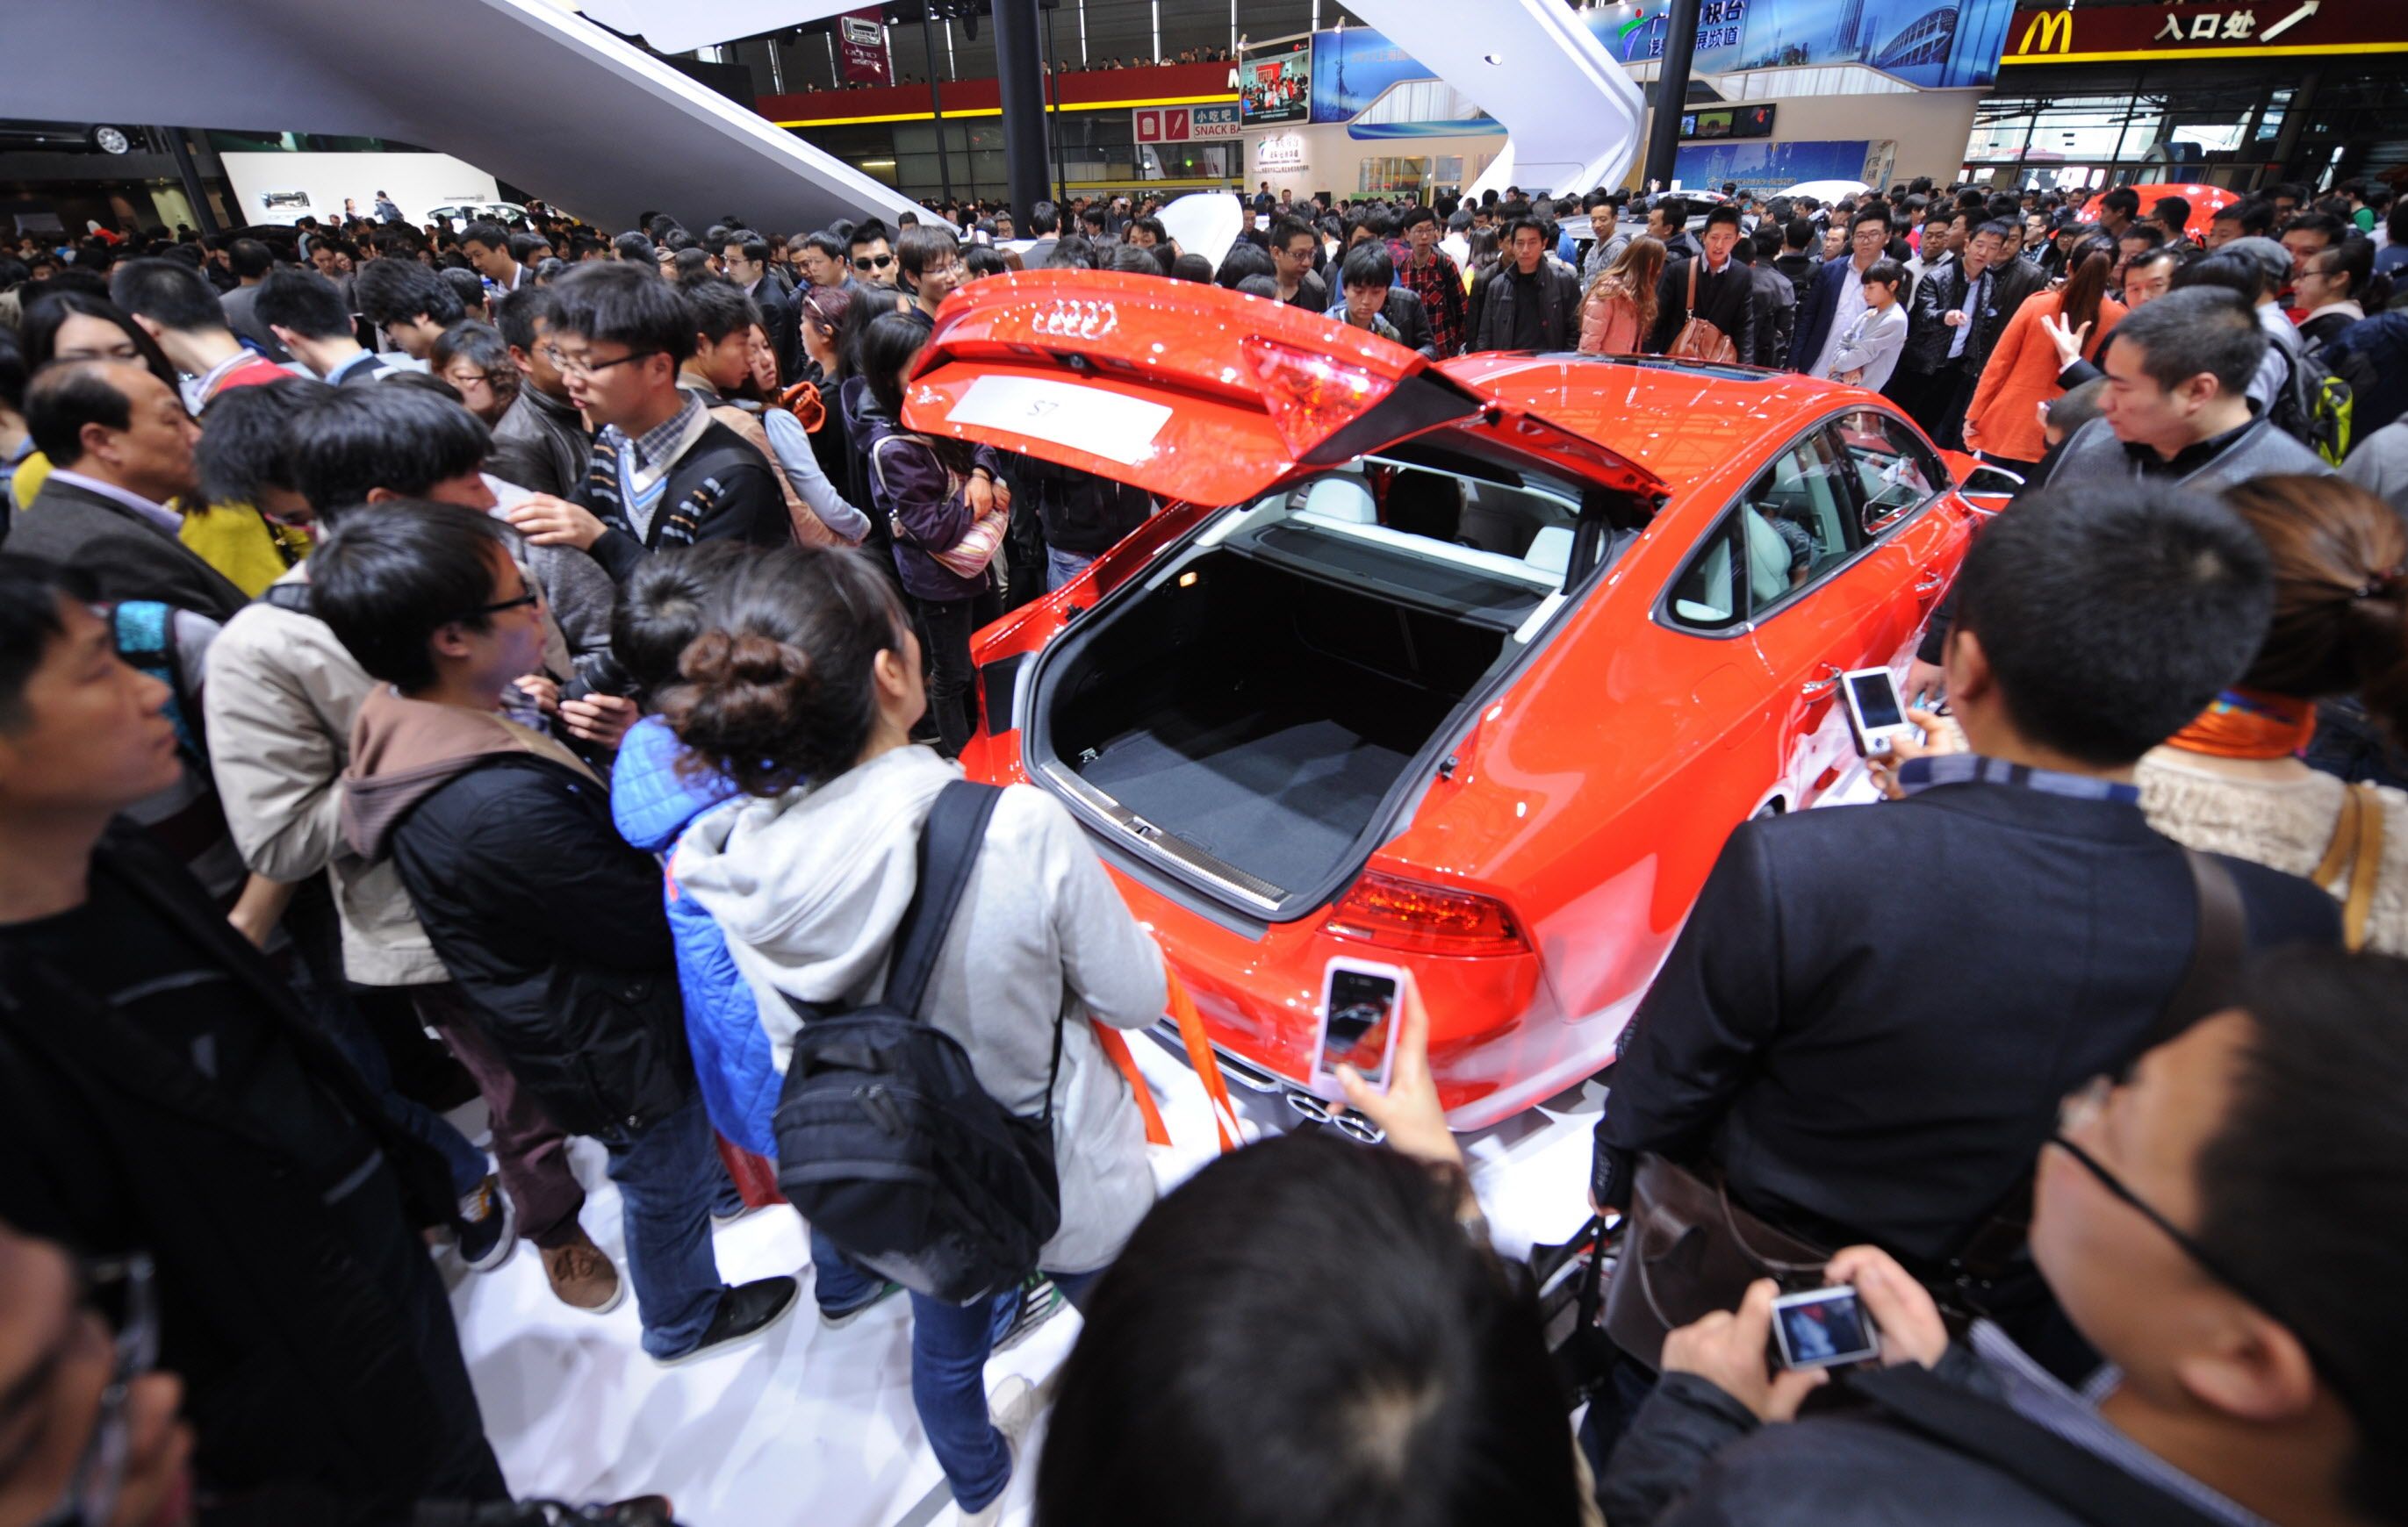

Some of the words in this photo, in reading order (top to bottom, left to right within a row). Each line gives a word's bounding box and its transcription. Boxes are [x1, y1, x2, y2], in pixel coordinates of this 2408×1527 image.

[2154, 10, 2256, 40] 入口处
[1197, 109, 1232, 123] 小吃吧
[1195, 125, 1227, 136] SNACK
[1026, 399, 1060, 417] S7
